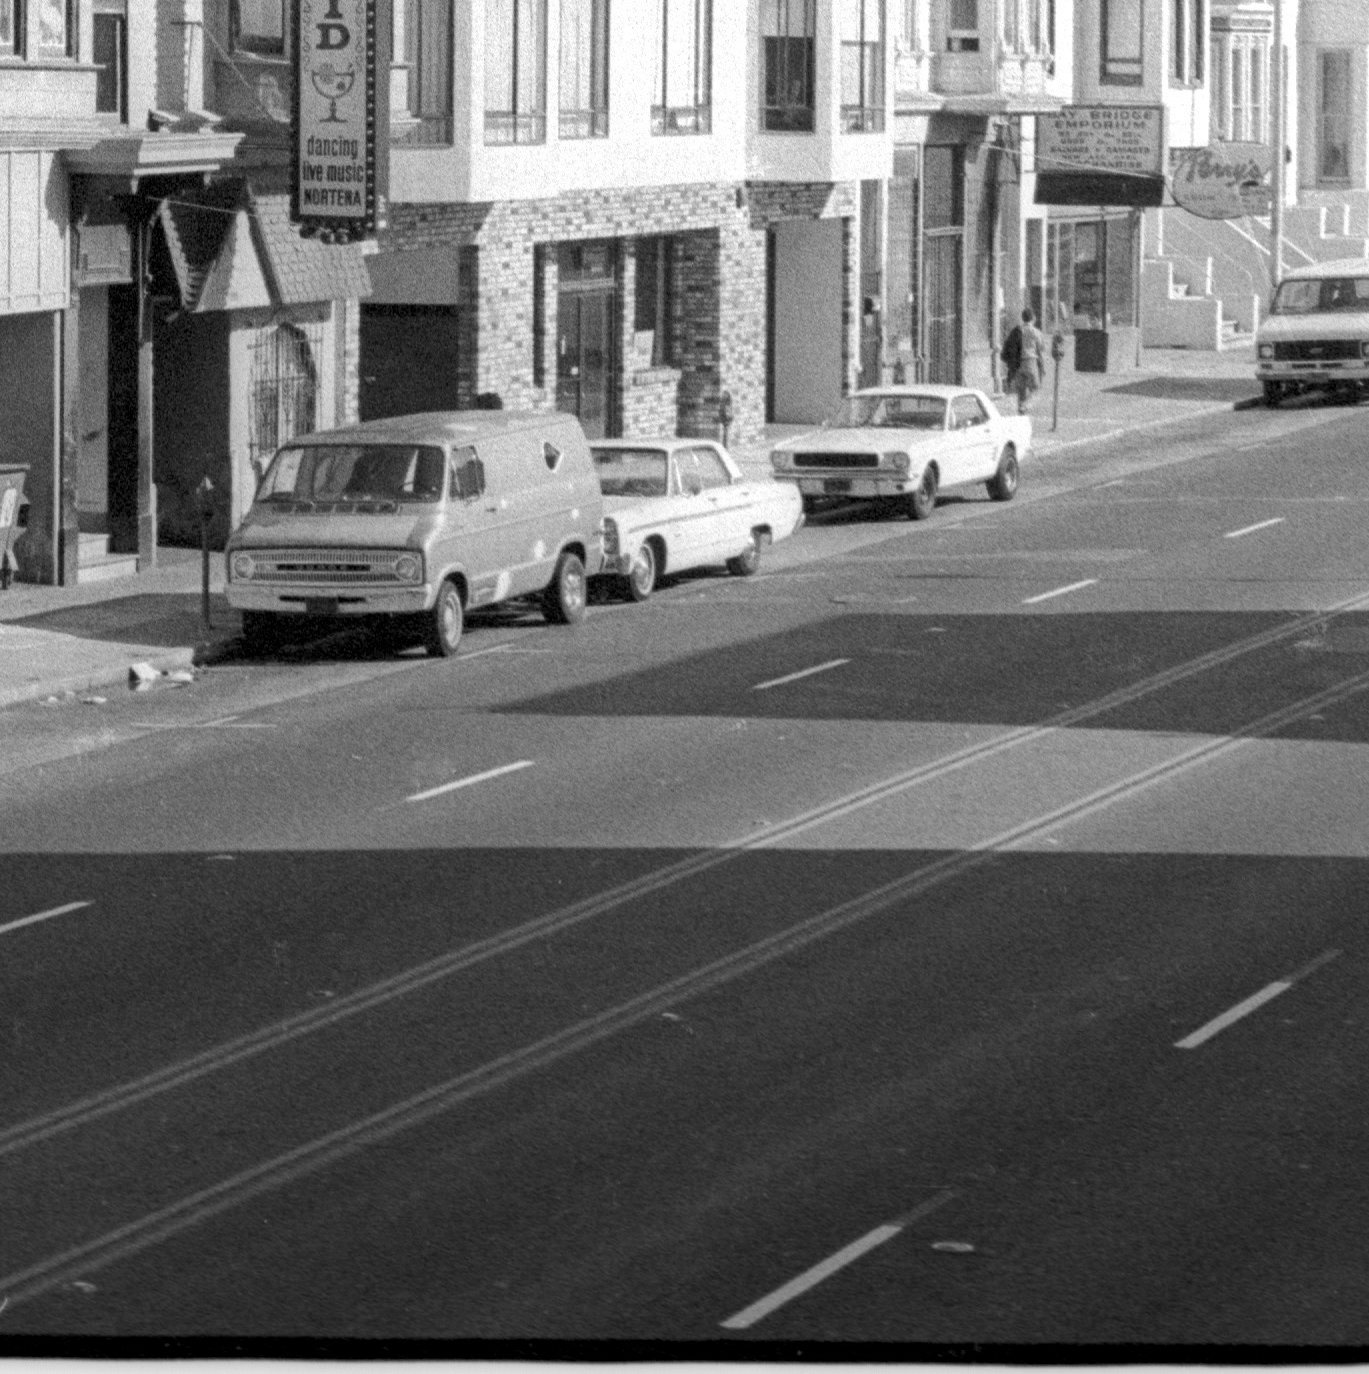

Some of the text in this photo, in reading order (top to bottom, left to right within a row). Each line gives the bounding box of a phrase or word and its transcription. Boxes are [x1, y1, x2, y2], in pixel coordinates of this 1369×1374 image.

[1054, 120, 1147, 130] EMPORIUM
[307, 135, 359, 160] dancing
[303, 161, 364, 182] live music
